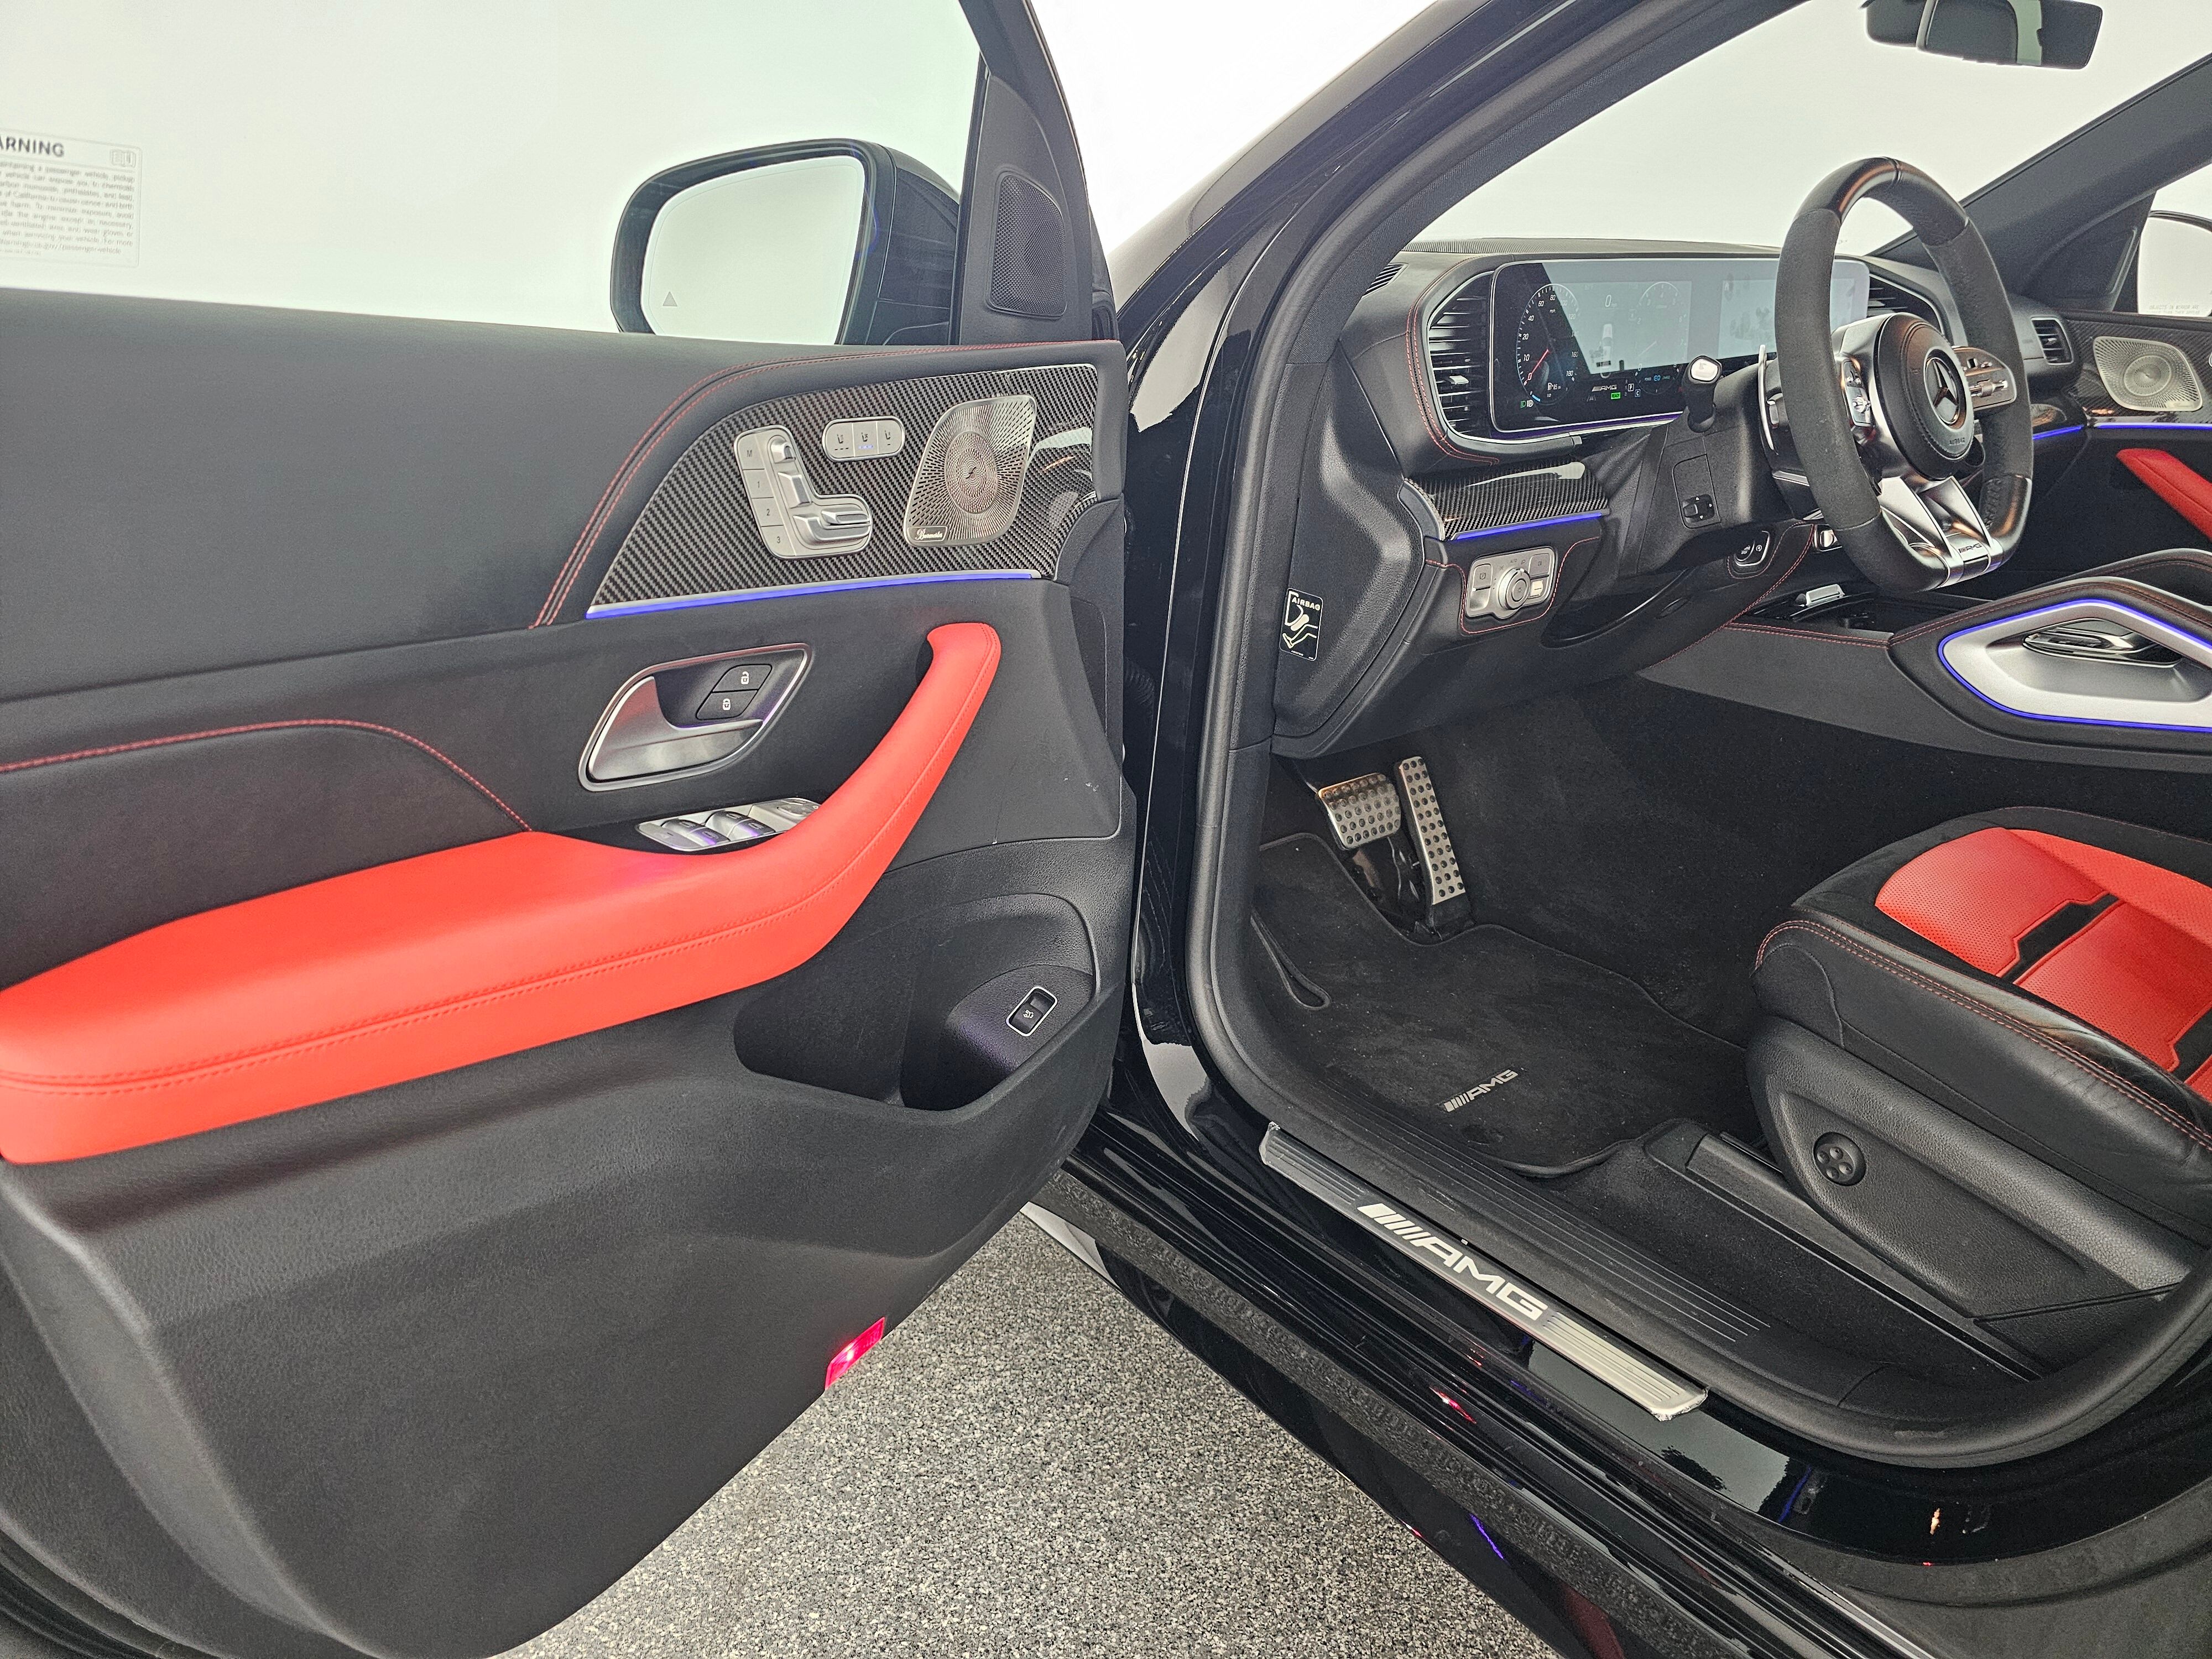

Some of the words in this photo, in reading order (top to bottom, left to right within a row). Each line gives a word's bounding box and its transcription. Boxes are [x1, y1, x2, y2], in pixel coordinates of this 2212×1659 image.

[1605, 294, 1611, 307] 0
[1291, 597, 1321, 611] AIRBAG
[1467, 1069, 1519, 1100] AMG
[1410, 1236, 1548, 1321] AMG
